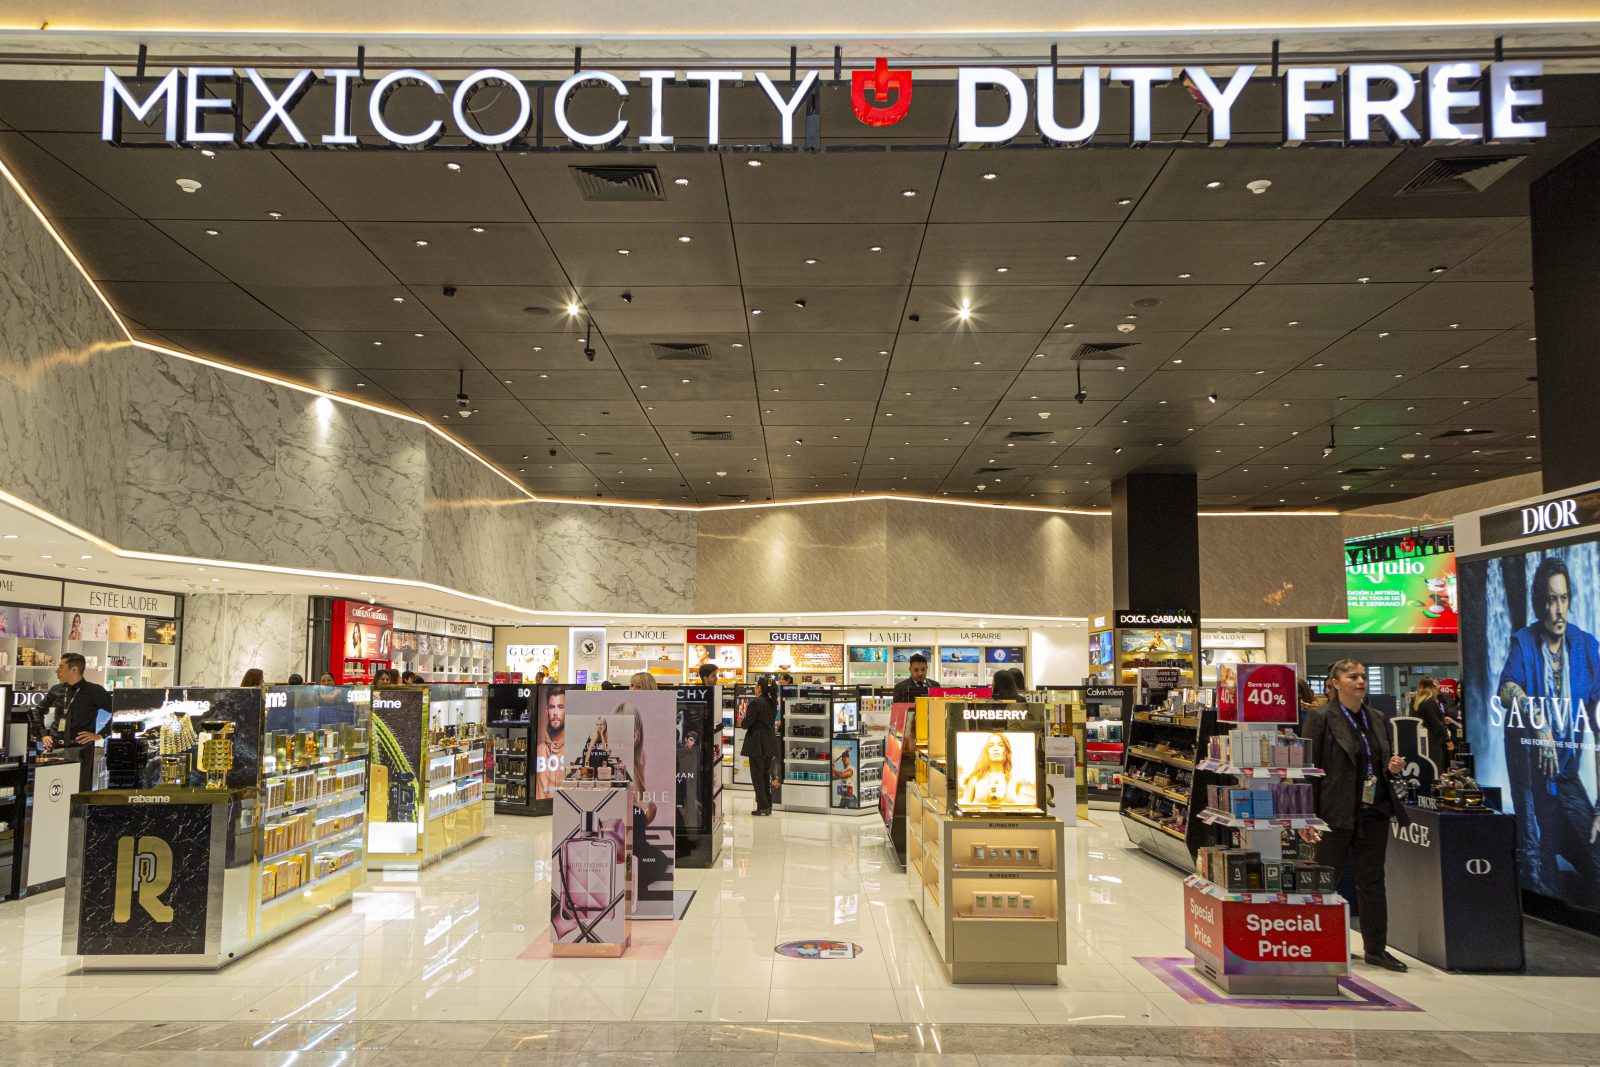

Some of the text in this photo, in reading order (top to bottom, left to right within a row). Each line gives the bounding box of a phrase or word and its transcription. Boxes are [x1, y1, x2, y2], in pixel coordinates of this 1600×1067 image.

[103, 66, 820, 146] MEXICO CITY
[957, 60, 1548, 143] DUTY FREE
[1521, 499, 1580, 535] DIOR
[121, 595, 158, 612] LAUDER
[1120, 615, 1147, 624] DOLCE
[1150, 615, 1193, 624] GABBANA
[450, 622, 458, 631] TOM
[458, 623, 467, 635] FORD
[623, 630, 669, 640] CLINIQUE
[695, 633, 736, 641] CLARINS
[771, 633, 820, 642] GUERLAIN
[869, 633, 912, 643] LA MER
[960, 632, 1002, 640] LA PRAIRIE
[676, 689, 708, 700] CHY
[1086, 688, 1125, 697] Calvin Klein
[1247, 689, 1286, 705] 40%
[963, 710, 1028, 720] BURBERRY
[128, 794, 170, 804] rabanne
[1417, 795, 1438, 810] DIOR
[1189, 898, 1215, 925] Special
[1246, 913, 1322, 936] Special
[1194, 924, 1212, 949] Price
[1258, 940, 1312, 958] Price
